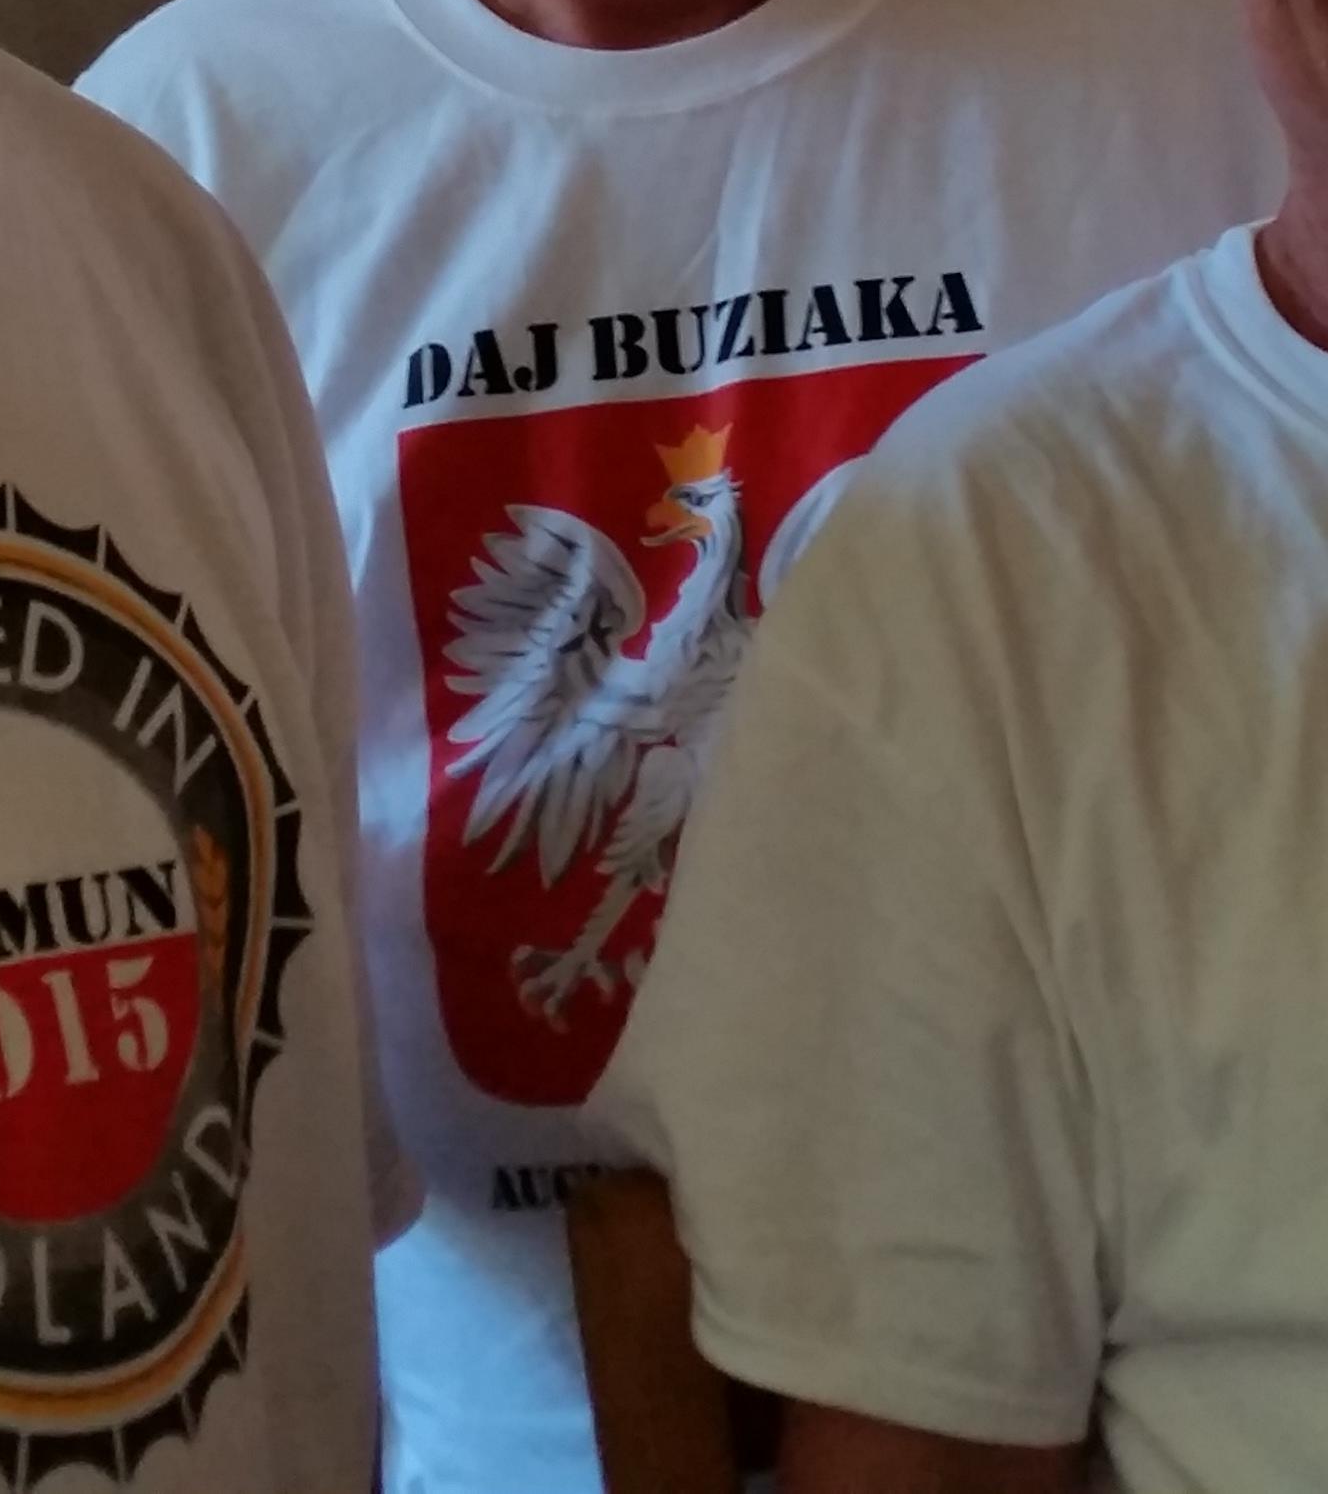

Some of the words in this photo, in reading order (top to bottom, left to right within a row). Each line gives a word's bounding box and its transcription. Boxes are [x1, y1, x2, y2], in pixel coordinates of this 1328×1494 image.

[403, 322, 560, 409] DAJ
[588, 271, 983, 381] BUZIAKA
[115, 657, 217, 796] IN
